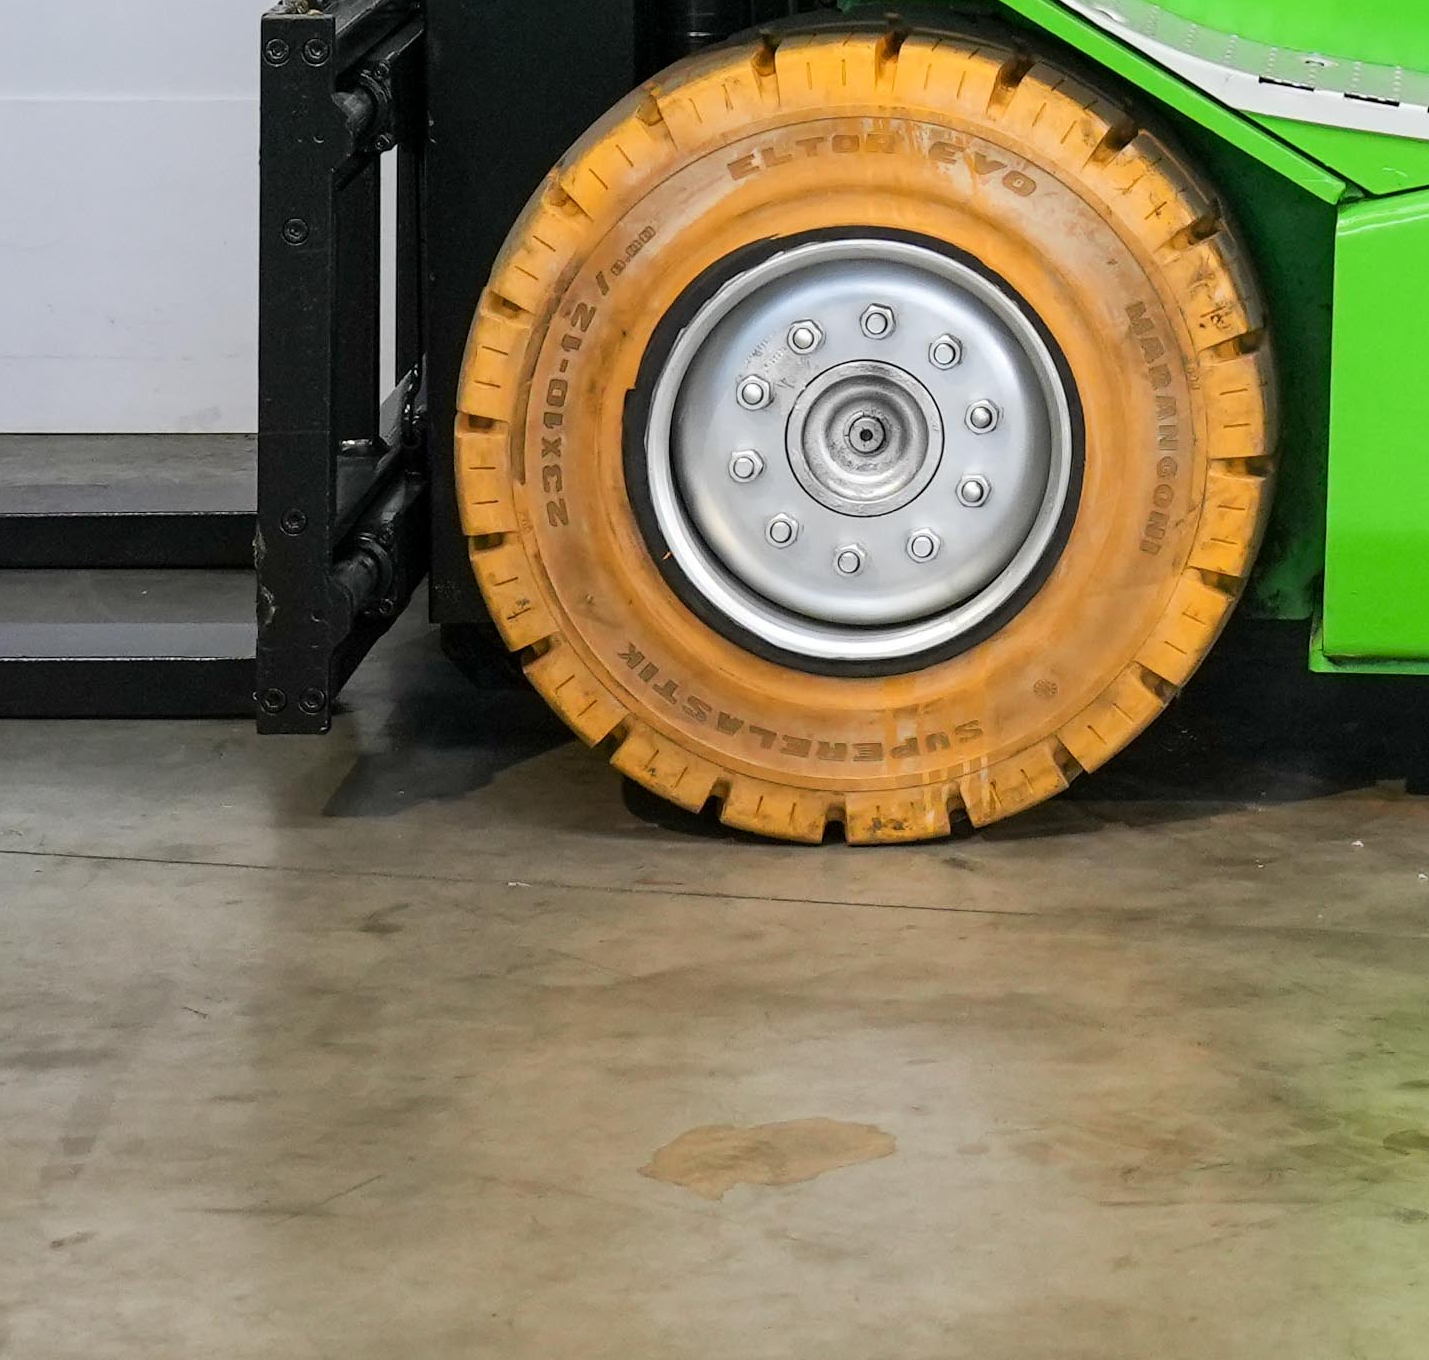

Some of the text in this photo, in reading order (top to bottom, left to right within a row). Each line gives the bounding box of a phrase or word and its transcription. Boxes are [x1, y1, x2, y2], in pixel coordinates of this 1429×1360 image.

[727, 133, 1038, 197] ELTOR EVO
[1125, 300, 1179, 555] MARANGONI
[617, 642, 984, 762] SUPERELASTIK
